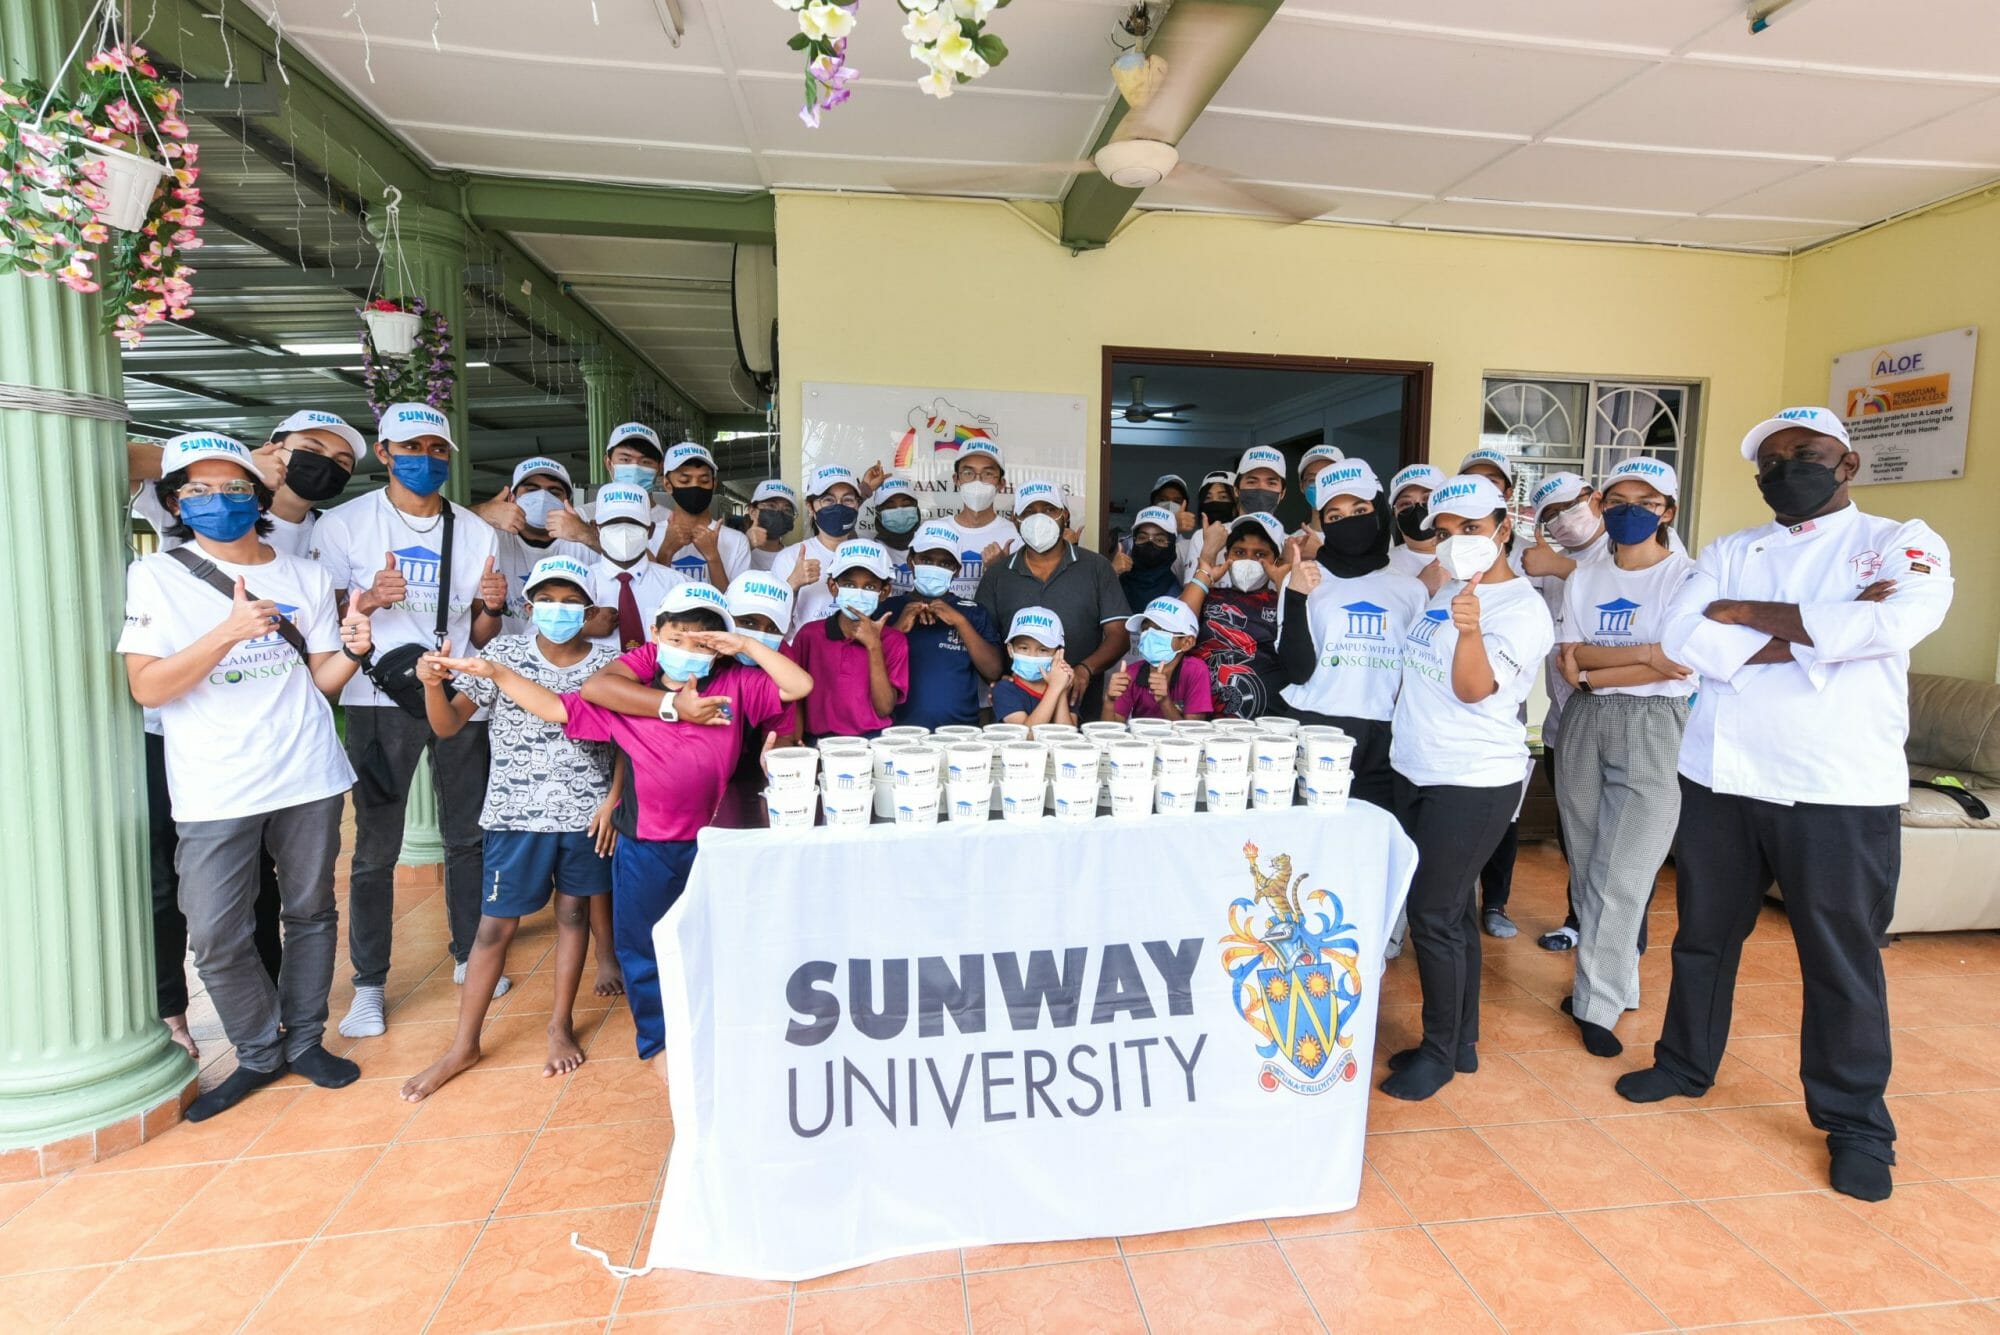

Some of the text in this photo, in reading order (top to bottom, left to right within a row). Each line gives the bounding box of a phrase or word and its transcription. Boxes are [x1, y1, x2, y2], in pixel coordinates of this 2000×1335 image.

[1876, 353, 1922, 375] ALOF
[308, 413, 343, 424] SUN
[398, 410, 444, 426] SUNWAY
[1777, 410, 1817, 419] WAY
[1884, 413, 1909, 422] grateful
[620, 426, 653, 437] SUNWAY
[1854, 424, 1889, 433] Foundation
[1902, 417, 1940, 427] sponsoring
[180, 438, 242, 456] SUNWAY
[673, 446, 707, 457] SUNWAY
[967, 441, 998, 454] SUNWAY
[1249, 451, 1281, 462] SUNWAY
[1472, 450, 1505, 462] SUNWAY
[523, 461, 560, 471] SUNWAY
[818, 466, 851, 477] SUNWAY
[1617, 462, 1664, 477] SUNWAY
[1321, 467, 1361, 487] SUNWAY
[1396, 468, 1431, 486] SUNWAY
[604, 490, 643, 503] SUNWAY
[766, 484, 794, 496] SUNWAY
[1020, 483, 1052, 497] SUNWAY
[1433, 483, 1477, 505] SUNWAY
[1533, 477, 1563, 504] SUNWAY
[1141, 511, 1170, 520] SUNWAY
[925, 527, 959, 543] SUNWAY
[841, 545, 880, 557] SUNWAY
[540, 560, 588, 577] SUNWAY
[686, 588, 728, 609] SUNWAY
[744, 582, 788, 602] SUNWAY
[1151, 602, 1179, 614] NWAY
[1016, 614, 1053, 627] SUNWAY
[1325, 642, 1366, 652] CAMPUS
[1369, 645, 1395, 655] WITH
[1321, 655, 1400, 670] CONSCIENC
[785, 937, 1204, 1046] SUNWAY
[788, 1033, 1208, 1138] UNIVERSITY
